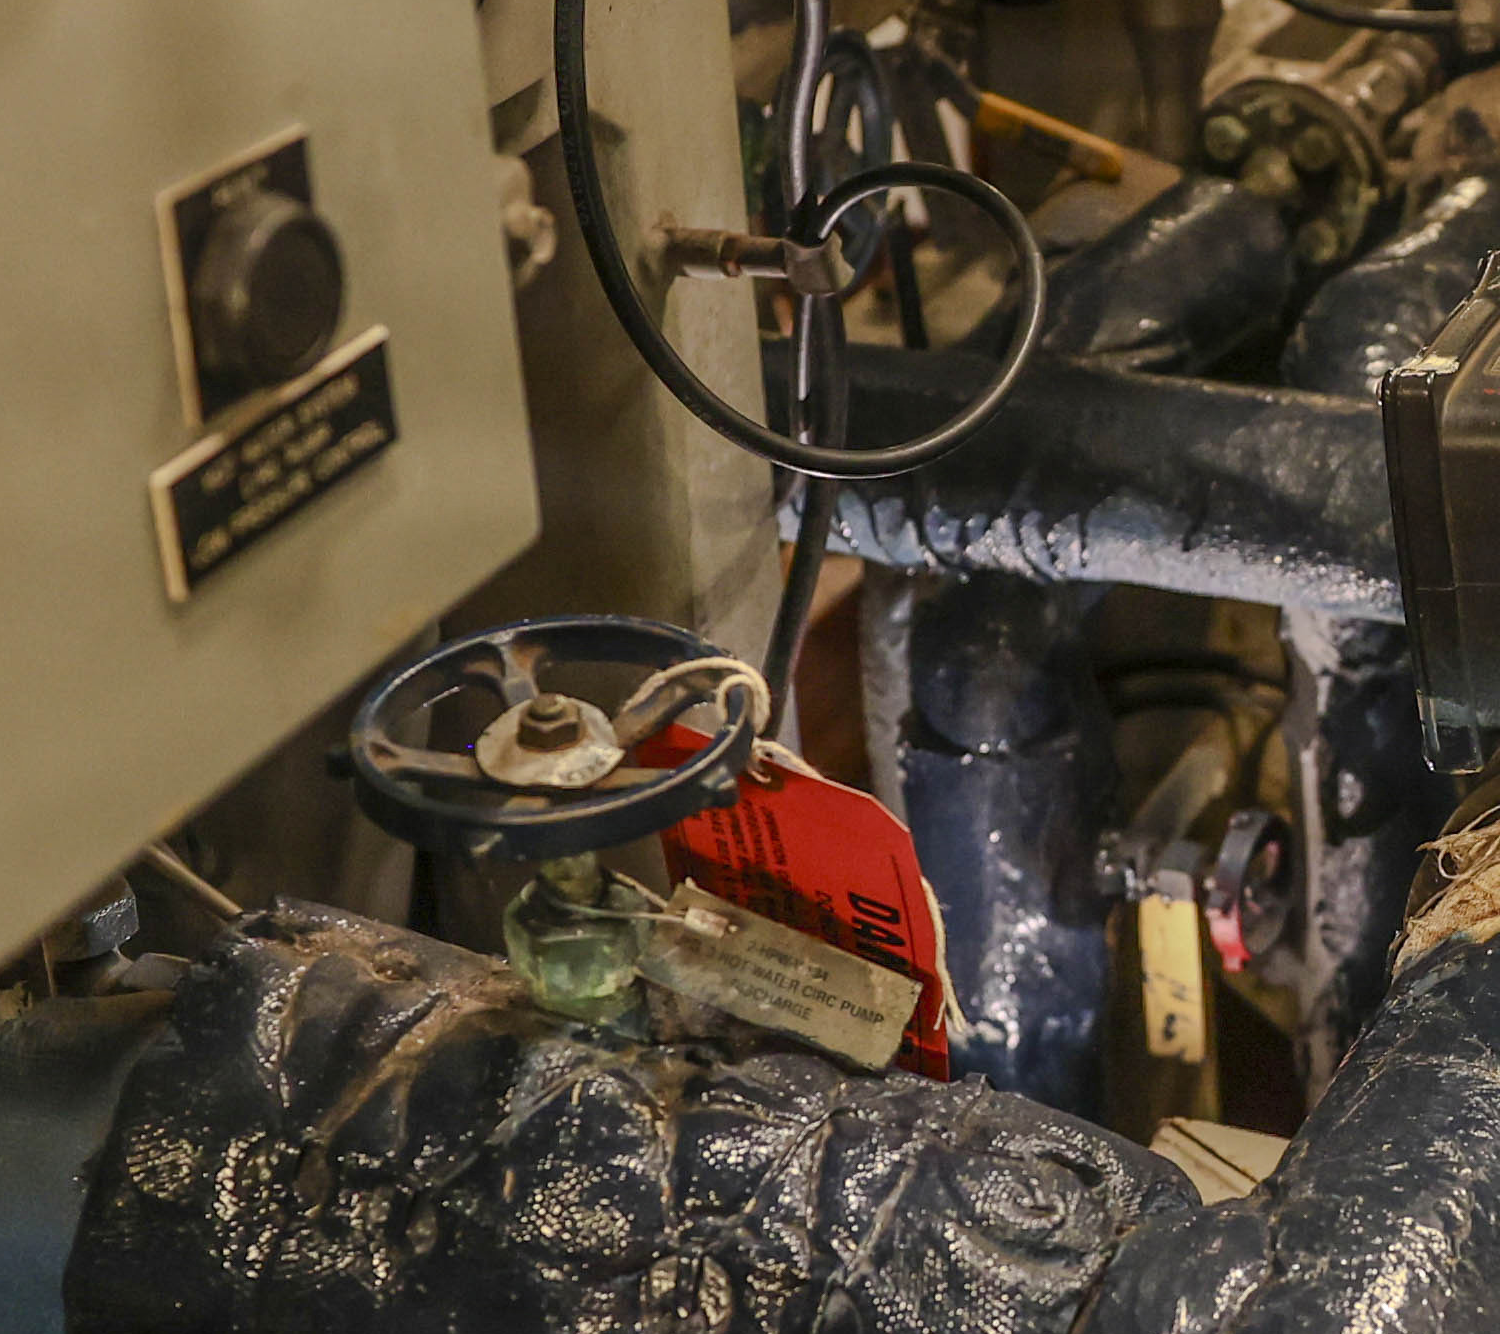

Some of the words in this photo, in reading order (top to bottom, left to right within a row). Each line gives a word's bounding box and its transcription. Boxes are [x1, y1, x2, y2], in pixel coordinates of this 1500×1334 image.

[752, 964, 801, 994] WATER
[801, 985, 838, 1008] CIRC
[840, 999, 886, 1025] PUMP
